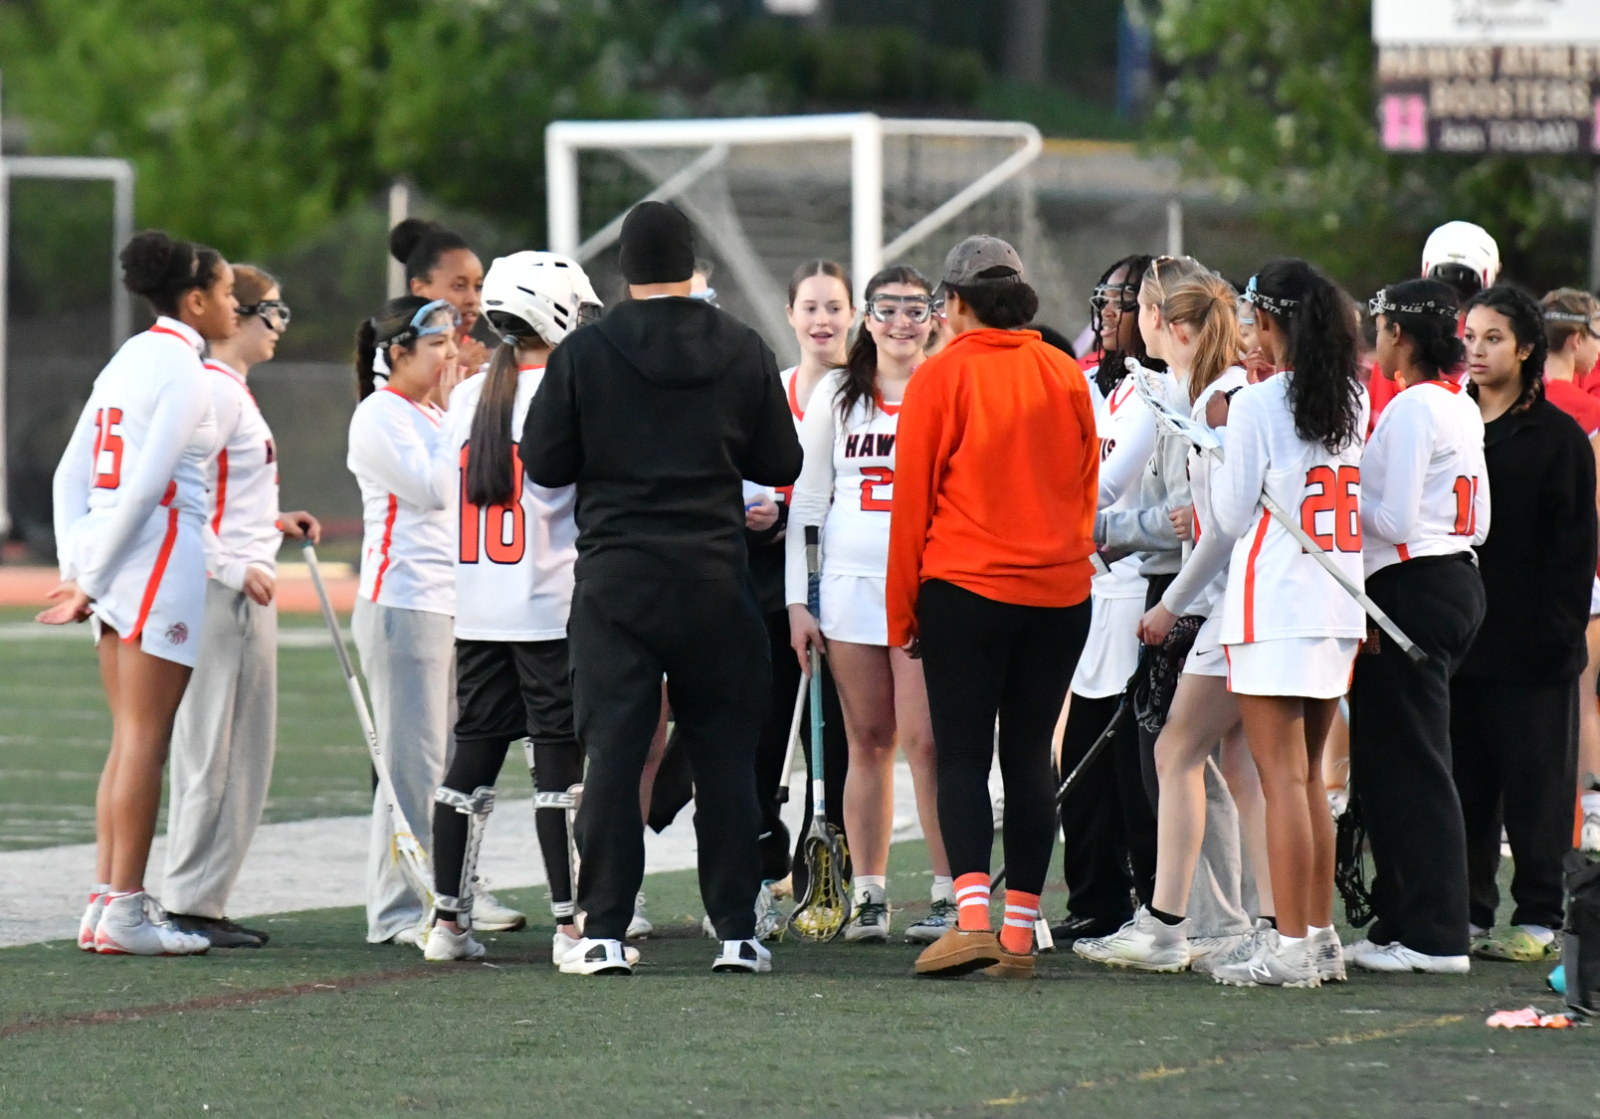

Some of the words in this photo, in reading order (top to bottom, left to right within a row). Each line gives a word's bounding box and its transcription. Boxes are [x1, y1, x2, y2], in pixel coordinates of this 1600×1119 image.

[1430, 78, 1591, 120] BOOSTERS
[459, 439, 526, 565] 18
[1301, 465, 1362, 554] 26
[434, 788, 477, 812] STX
